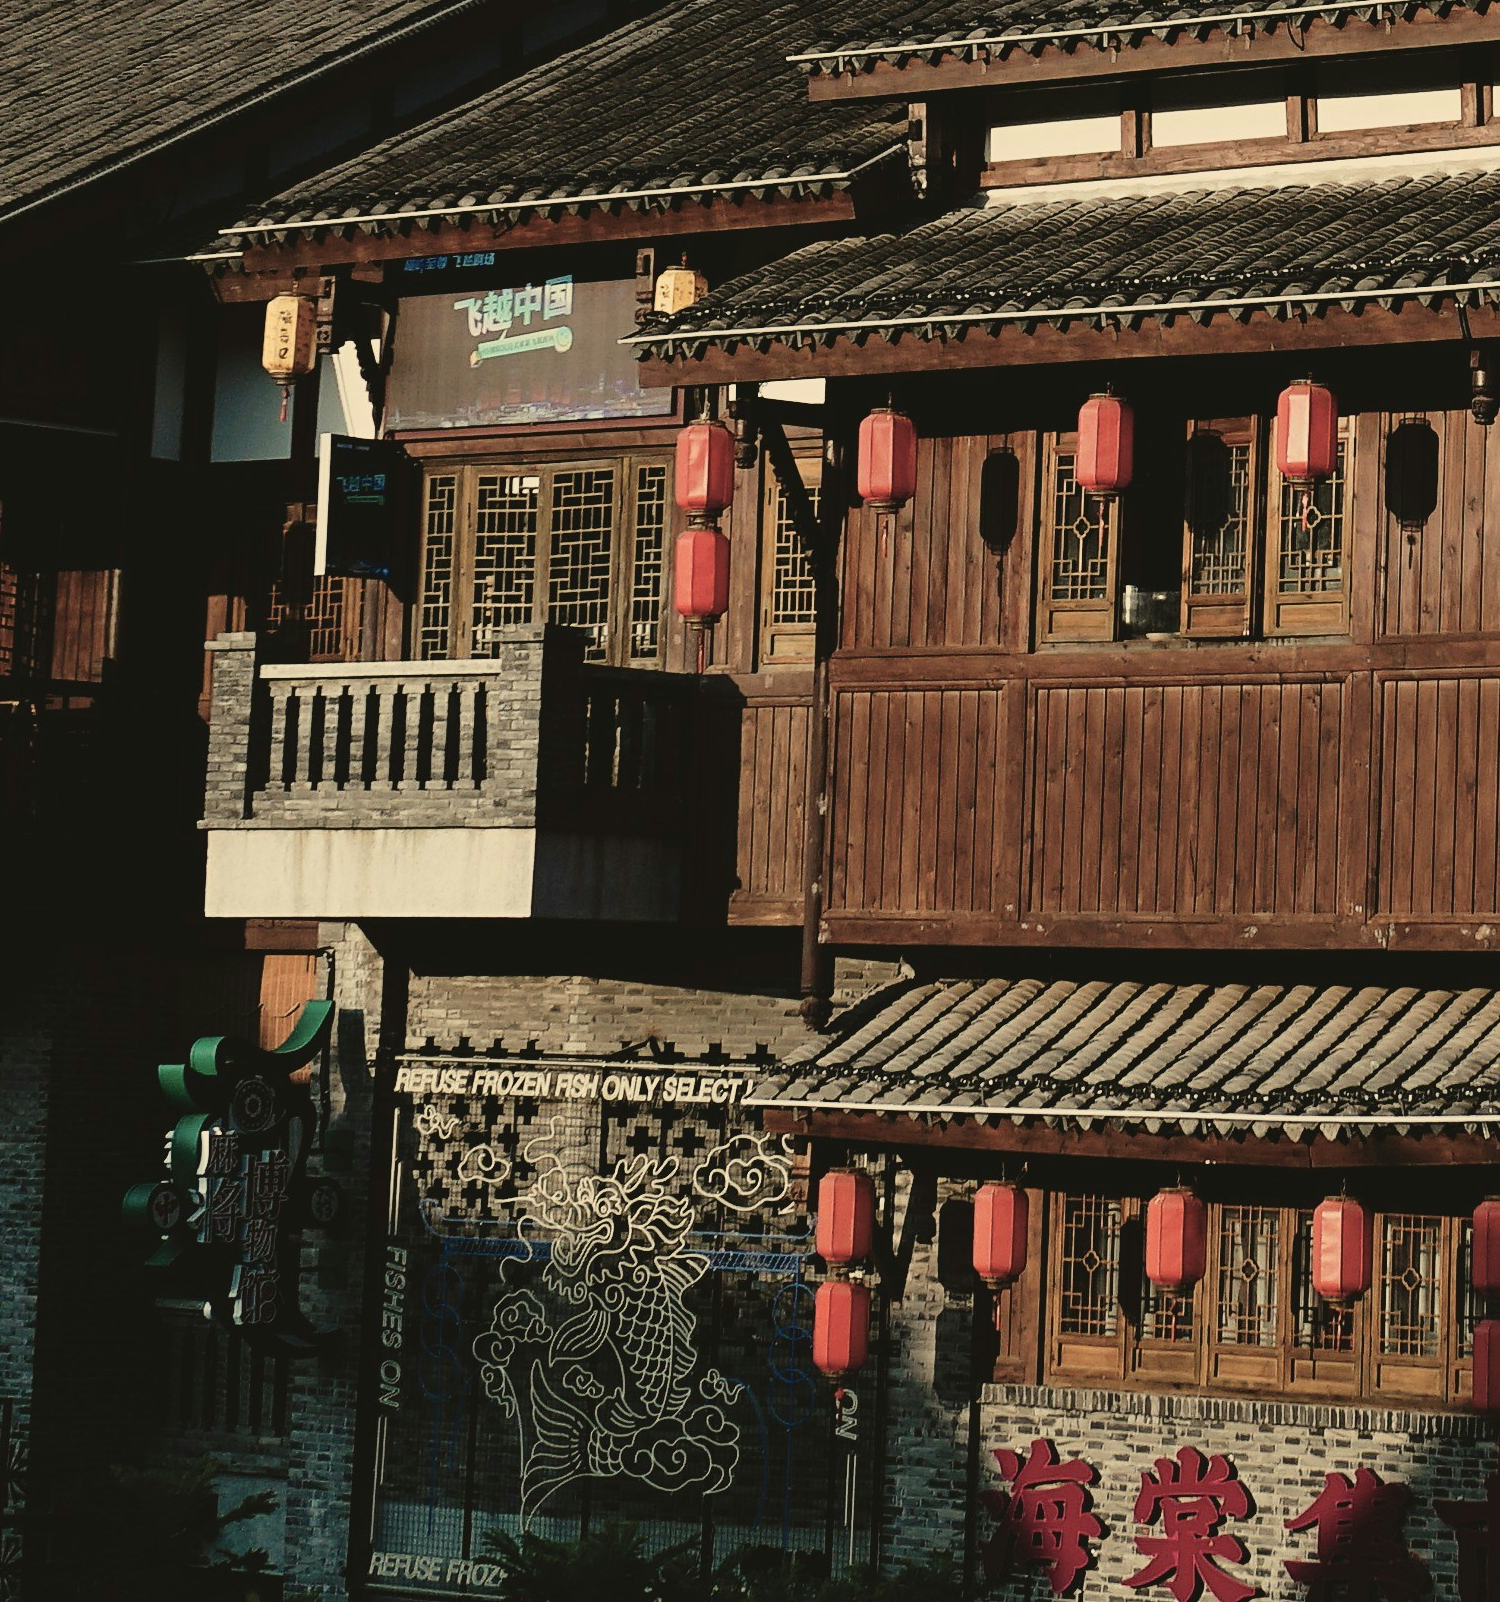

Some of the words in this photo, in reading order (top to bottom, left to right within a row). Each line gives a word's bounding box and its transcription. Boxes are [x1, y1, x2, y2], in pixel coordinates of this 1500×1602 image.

[453, 274, 574, 337] 飞越中国
[394, 1068, 467, 1094] REFUSE
[470, 1070, 551, 1098] FROZEN
[554, 1072, 600, 1099] FISH
[601, 1074, 661, 1102] ONLY
[662, 1076, 742, 1104] SELECT
[381, 1245, 408, 1349] FISHES
[379, 1359, 402, 1408] ON
[835, 1388, 858, 1441] ON
[367, 1551, 445, 1582] REFUSE
[445, 1558, 508, 1588] FROZ
